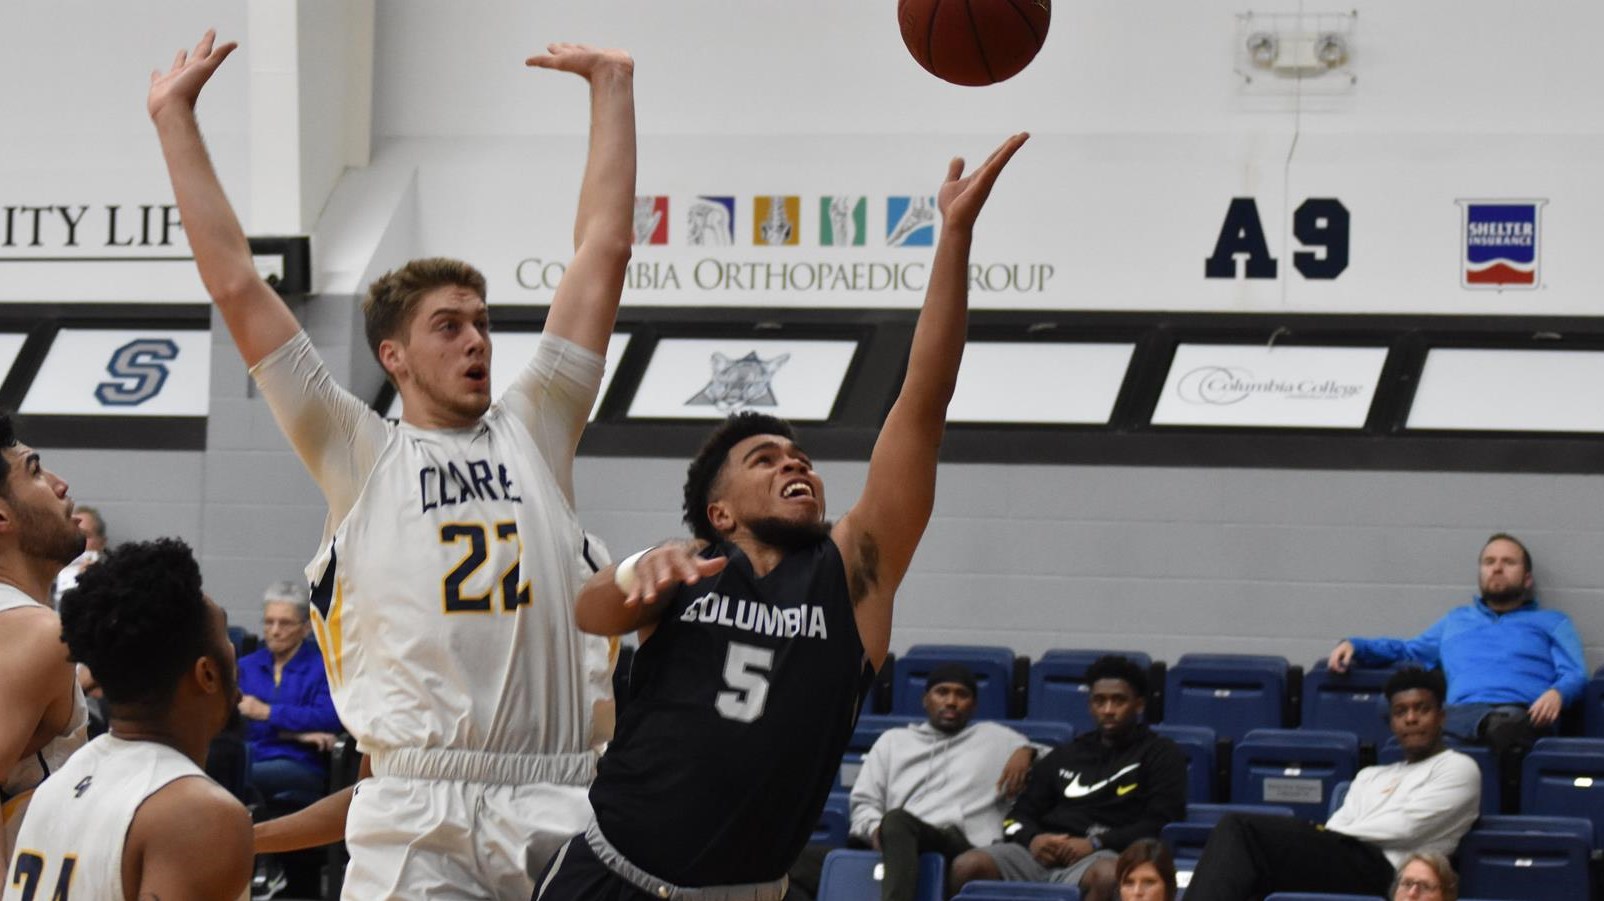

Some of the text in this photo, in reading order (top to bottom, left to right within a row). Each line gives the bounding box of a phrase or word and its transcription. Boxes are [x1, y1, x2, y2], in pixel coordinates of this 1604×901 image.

[104, 205, 184, 247] LIF
[1468, 221, 1534, 236] SHELTER
[1468, 236, 1533, 247] INSURANCE
[515, 258, 1055, 293] COBIA ORTHOPAEDIC ROUP
[94, 338, 180, 406] S
[440, 522, 533, 615] 22
[680, 591, 828, 640] COLUMBIA
[714, 640, 775, 724] 5
